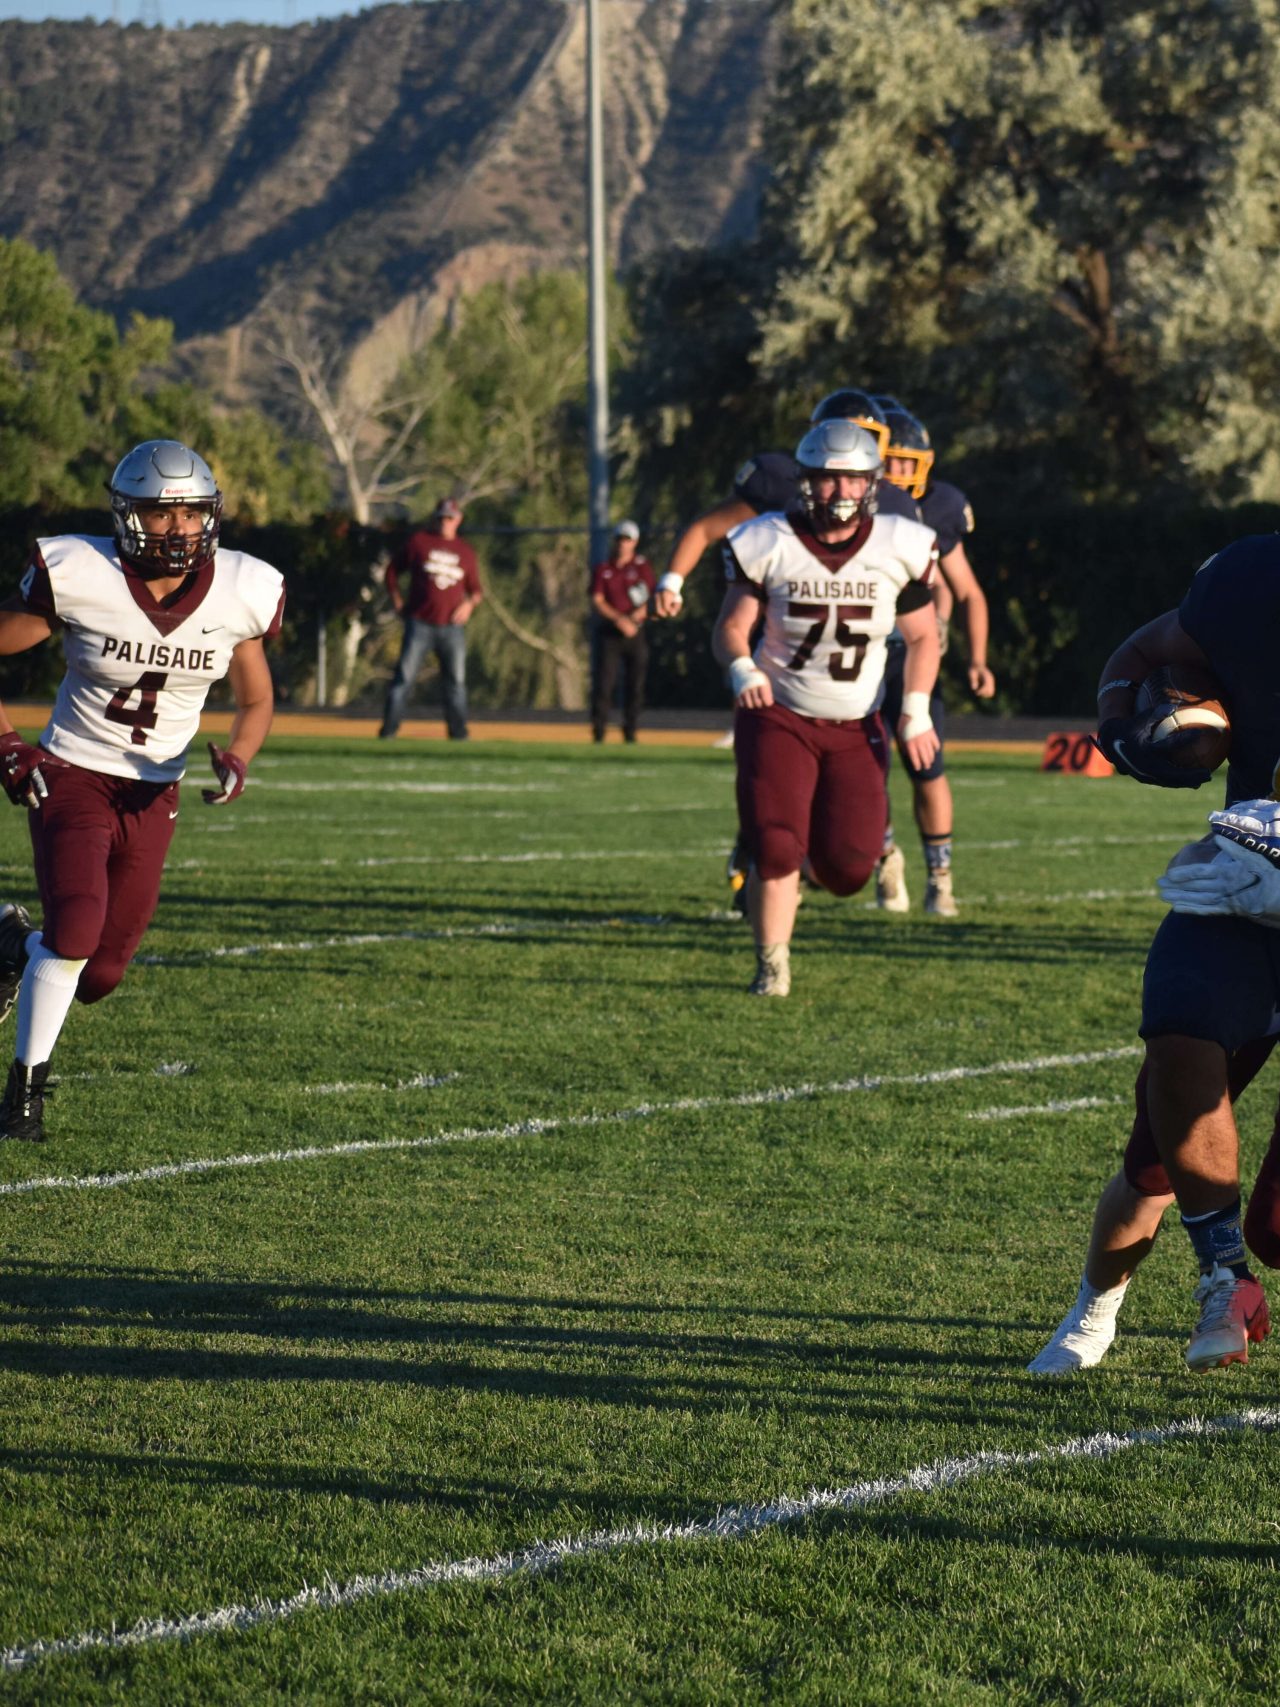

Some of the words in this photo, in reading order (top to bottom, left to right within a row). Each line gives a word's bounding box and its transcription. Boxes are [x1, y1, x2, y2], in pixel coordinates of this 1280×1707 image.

[788, 580, 878, 600] PALISADE
[101, 636, 216, 670] PALISADE
[786, 601, 874, 682] 75
[104, 671, 158, 746] 4
[1045, 736, 1093, 772] 20
